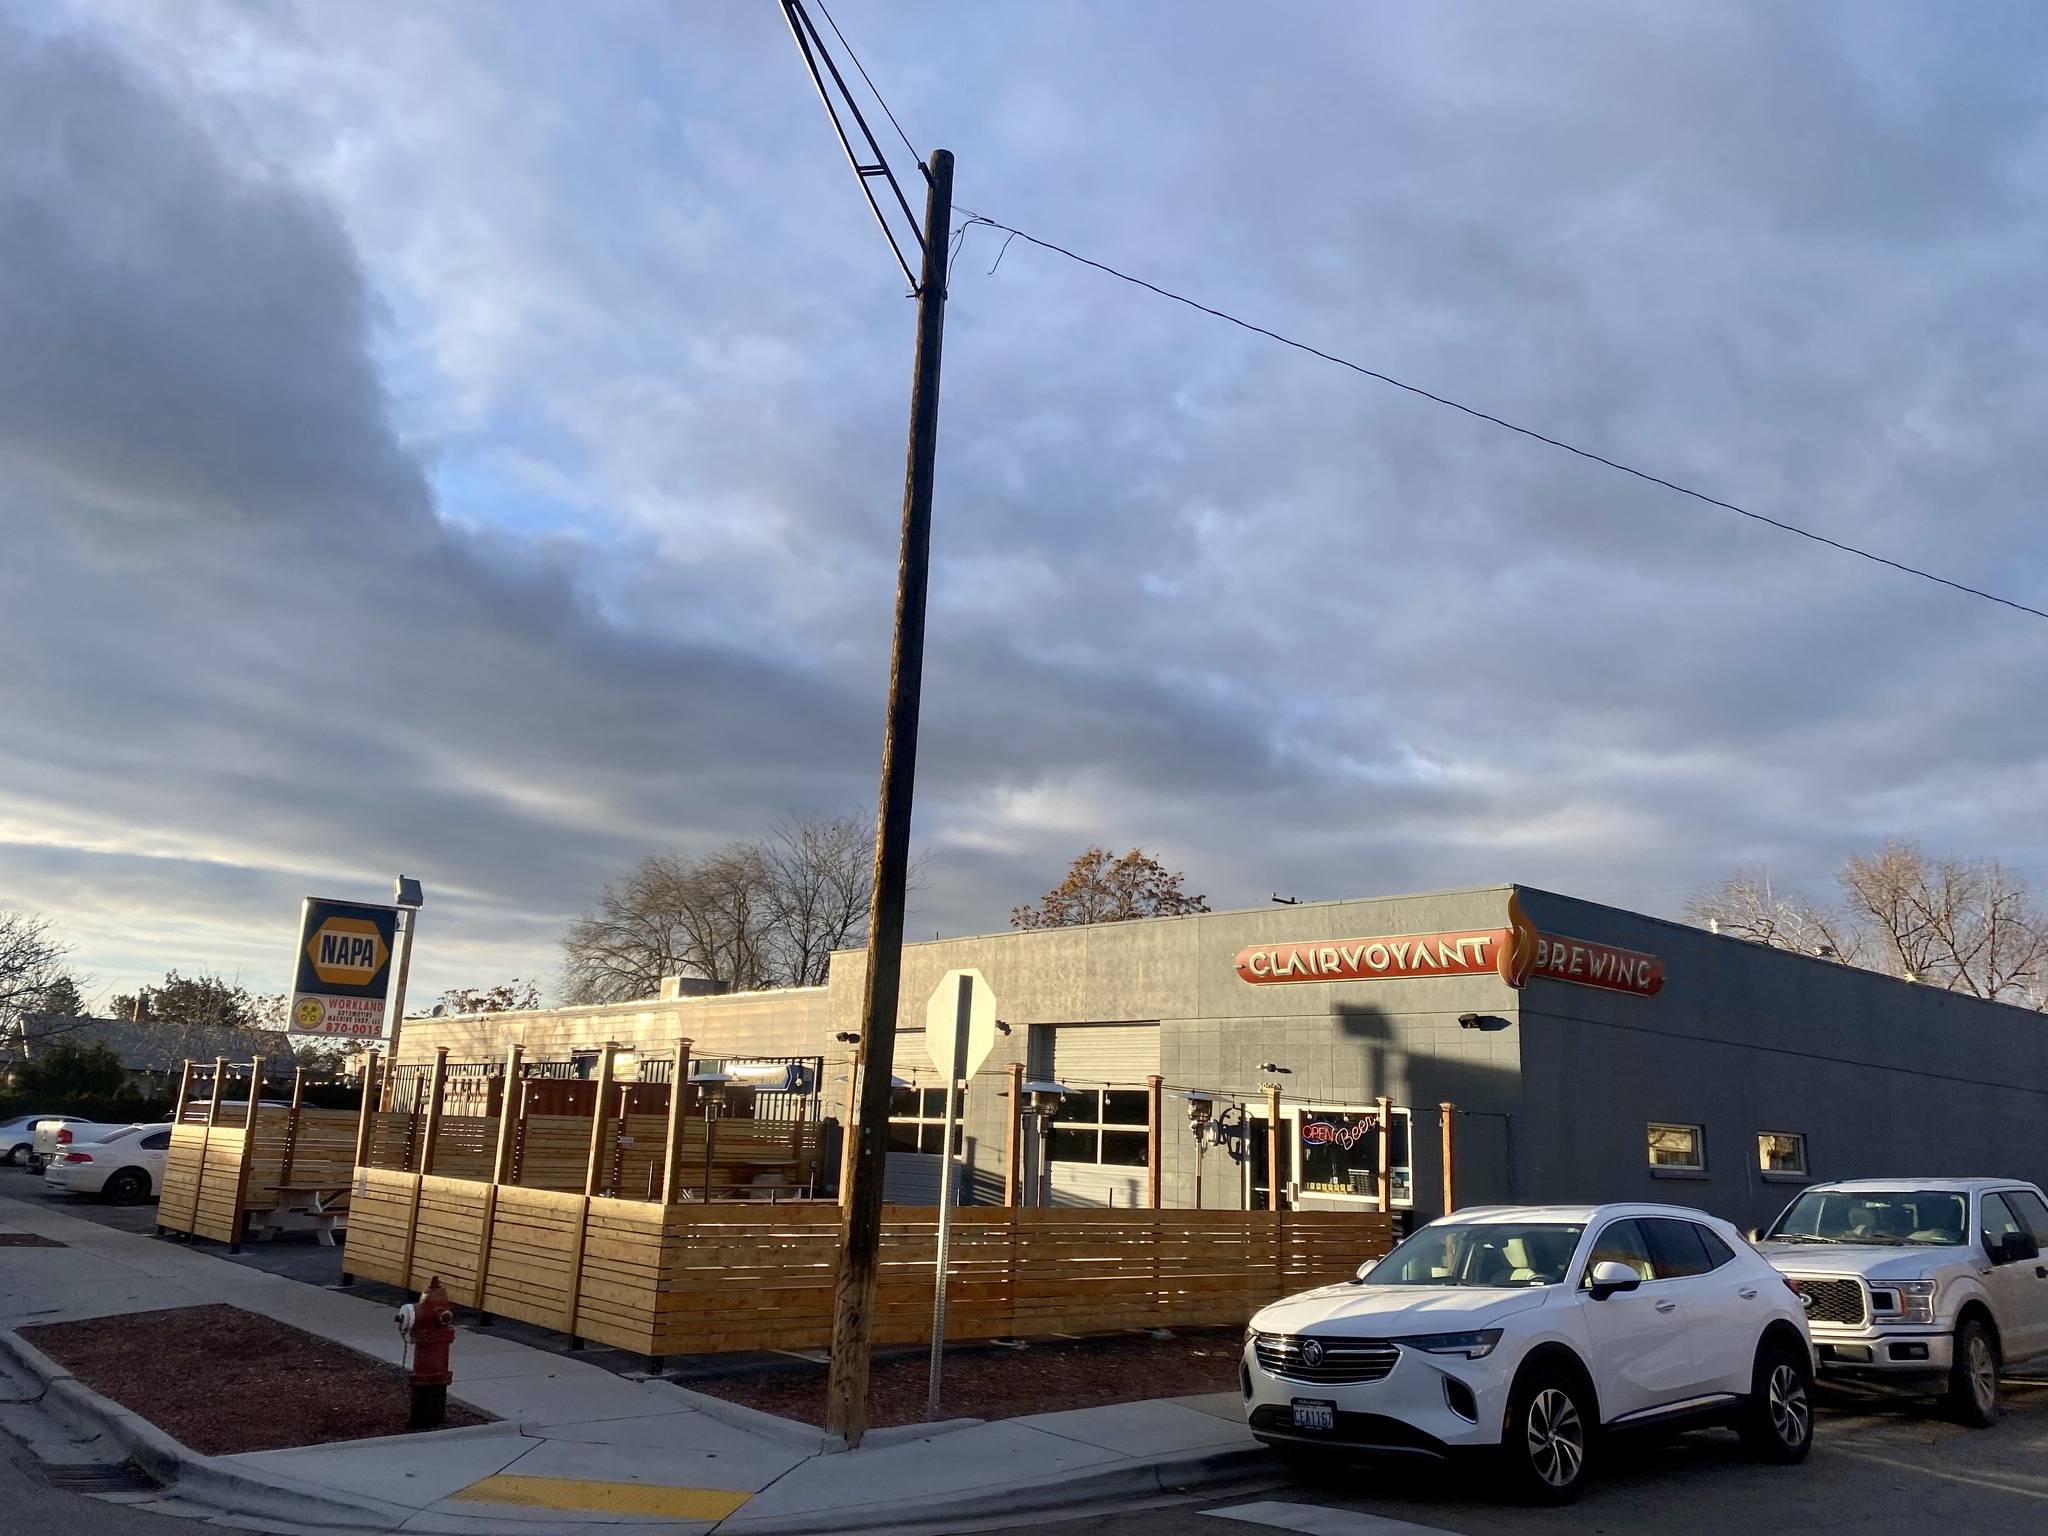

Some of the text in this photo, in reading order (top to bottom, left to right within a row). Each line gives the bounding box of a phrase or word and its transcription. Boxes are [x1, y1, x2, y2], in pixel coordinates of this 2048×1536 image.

[321, 935, 373, 967] NAPA
[1249, 936, 1491, 977] CLAIRVOYANT
[1536, 939, 1651, 988] BREWING
[329, 998, 384, 1012] WORKLAND
[328, 1015, 352, 1023] MACHINE
[338, 1010, 373, 1019] AUTOMOTIVE
[325, 1022, 381, 1035] 870-0015
[1302, 1125, 1334, 1142] OPEN
[1335, 1115, 1376, 1151] Beer
[1295, 1409, 1332, 1427] CEA1167
